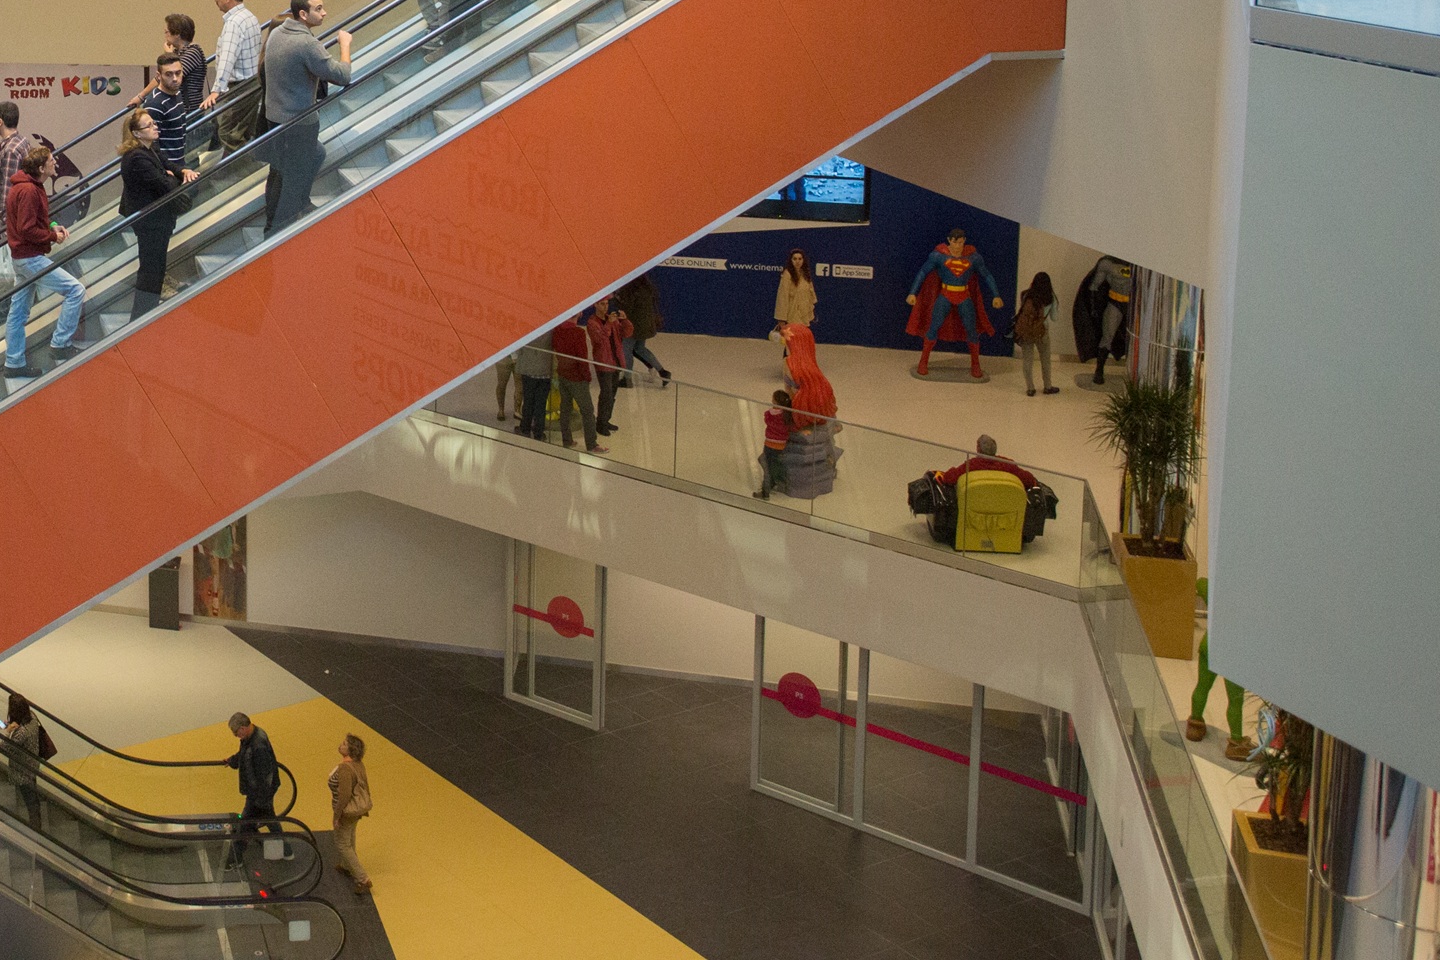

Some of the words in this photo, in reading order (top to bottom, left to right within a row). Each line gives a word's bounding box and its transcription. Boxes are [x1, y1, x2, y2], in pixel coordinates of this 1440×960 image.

[4, 76, 56, 88] SCARY
[61, 75, 122, 98] KIDS
[10, 88, 50, 99] ROOM
[686, 258, 717, 268] ONLINE
